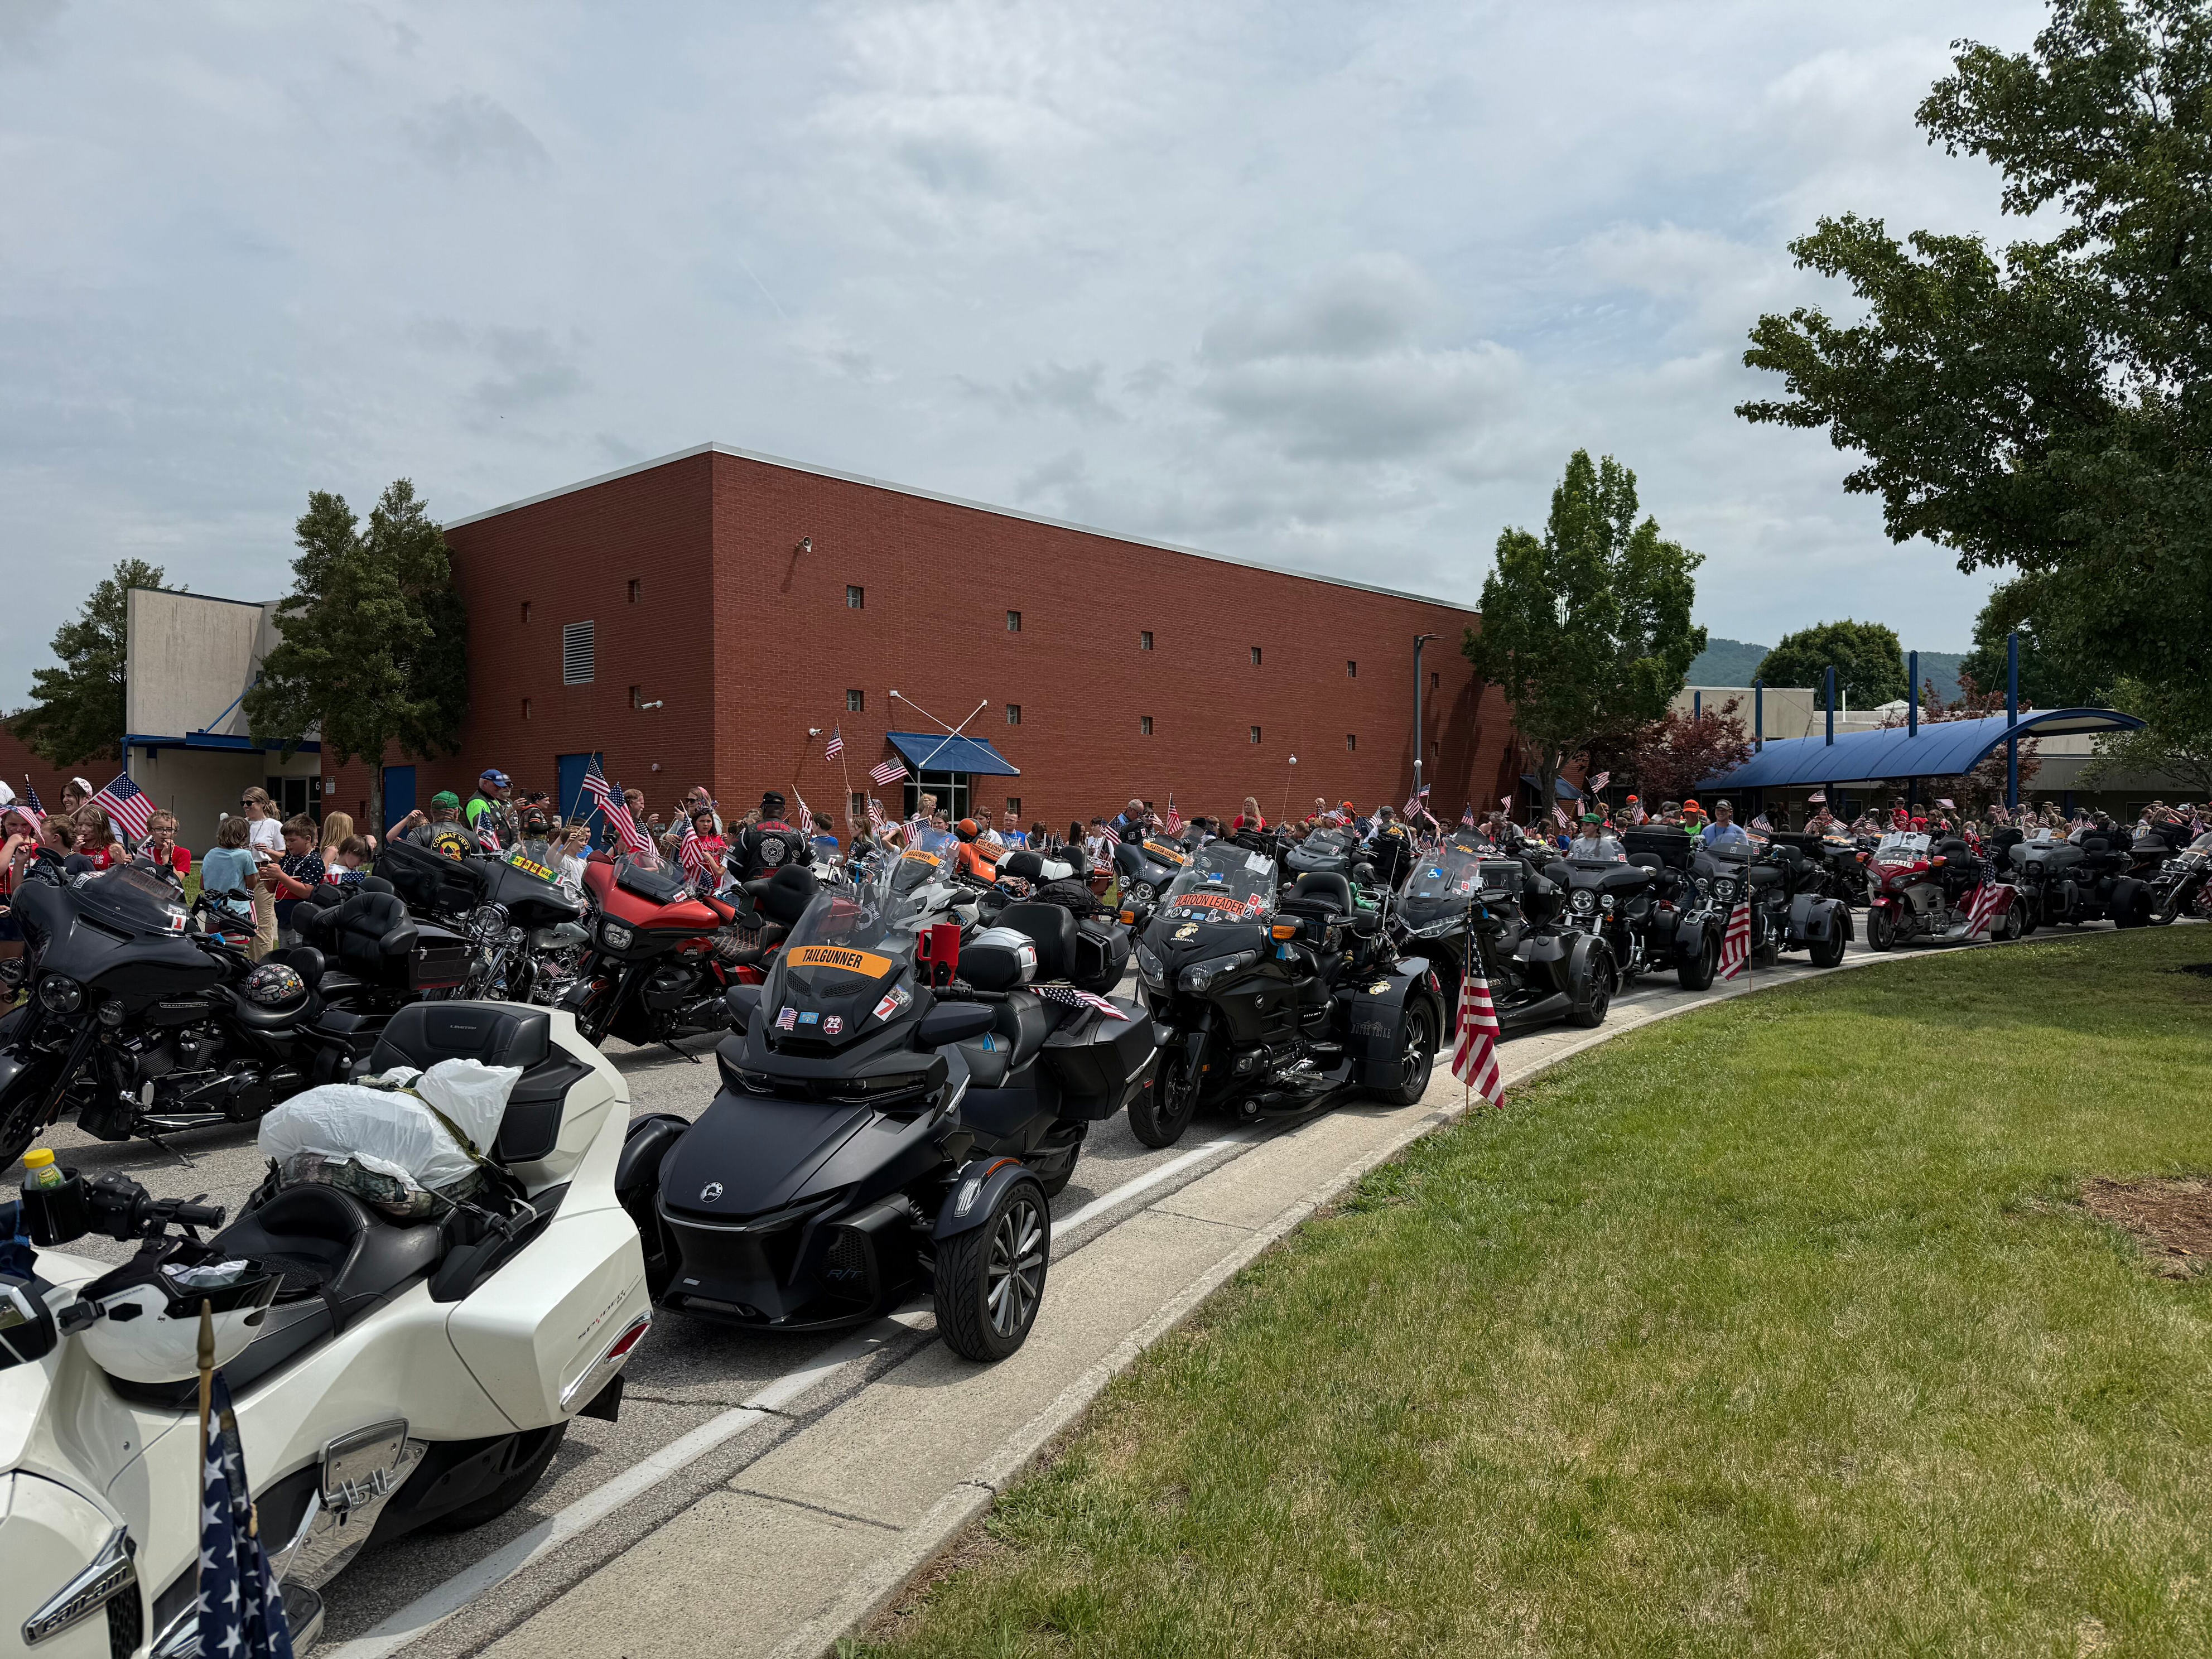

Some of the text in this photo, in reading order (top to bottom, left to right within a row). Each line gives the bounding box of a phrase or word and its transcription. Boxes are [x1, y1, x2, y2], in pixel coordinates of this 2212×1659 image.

[315, 782, 320, 790] 6
[432, 833, 470, 850] COMBAT VETS
[951, 841, 958, 849] 1
[986, 842, 1002, 853] PLATOON
[907, 850, 931, 861] TAILGUNNER
[1149, 844, 1178, 860] PLATOON LEADER
[1879, 860, 1914, 868] CHAPLAIN
[541, 869, 555, 880] WALL
[557, 876, 564, 885] 1
[1462, 882, 1469, 890] 8
[1174, 895, 1245, 915] PLATOON LEADER
[1249, 895, 1259, 906] 8
[174, 917, 182, 929] 1
[802, 949, 864, 968] TAILGUNNER
[1028, 947, 1035, 962] 7
[877, 997, 897, 1016] 7
[827, 1017, 841, 1029] 22
[1351, 1024, 1391, 1039] MOTOR TRIKE
[826, 1267, 863, 1281] R/T
[42, 1566, 128, 1633] can-am
